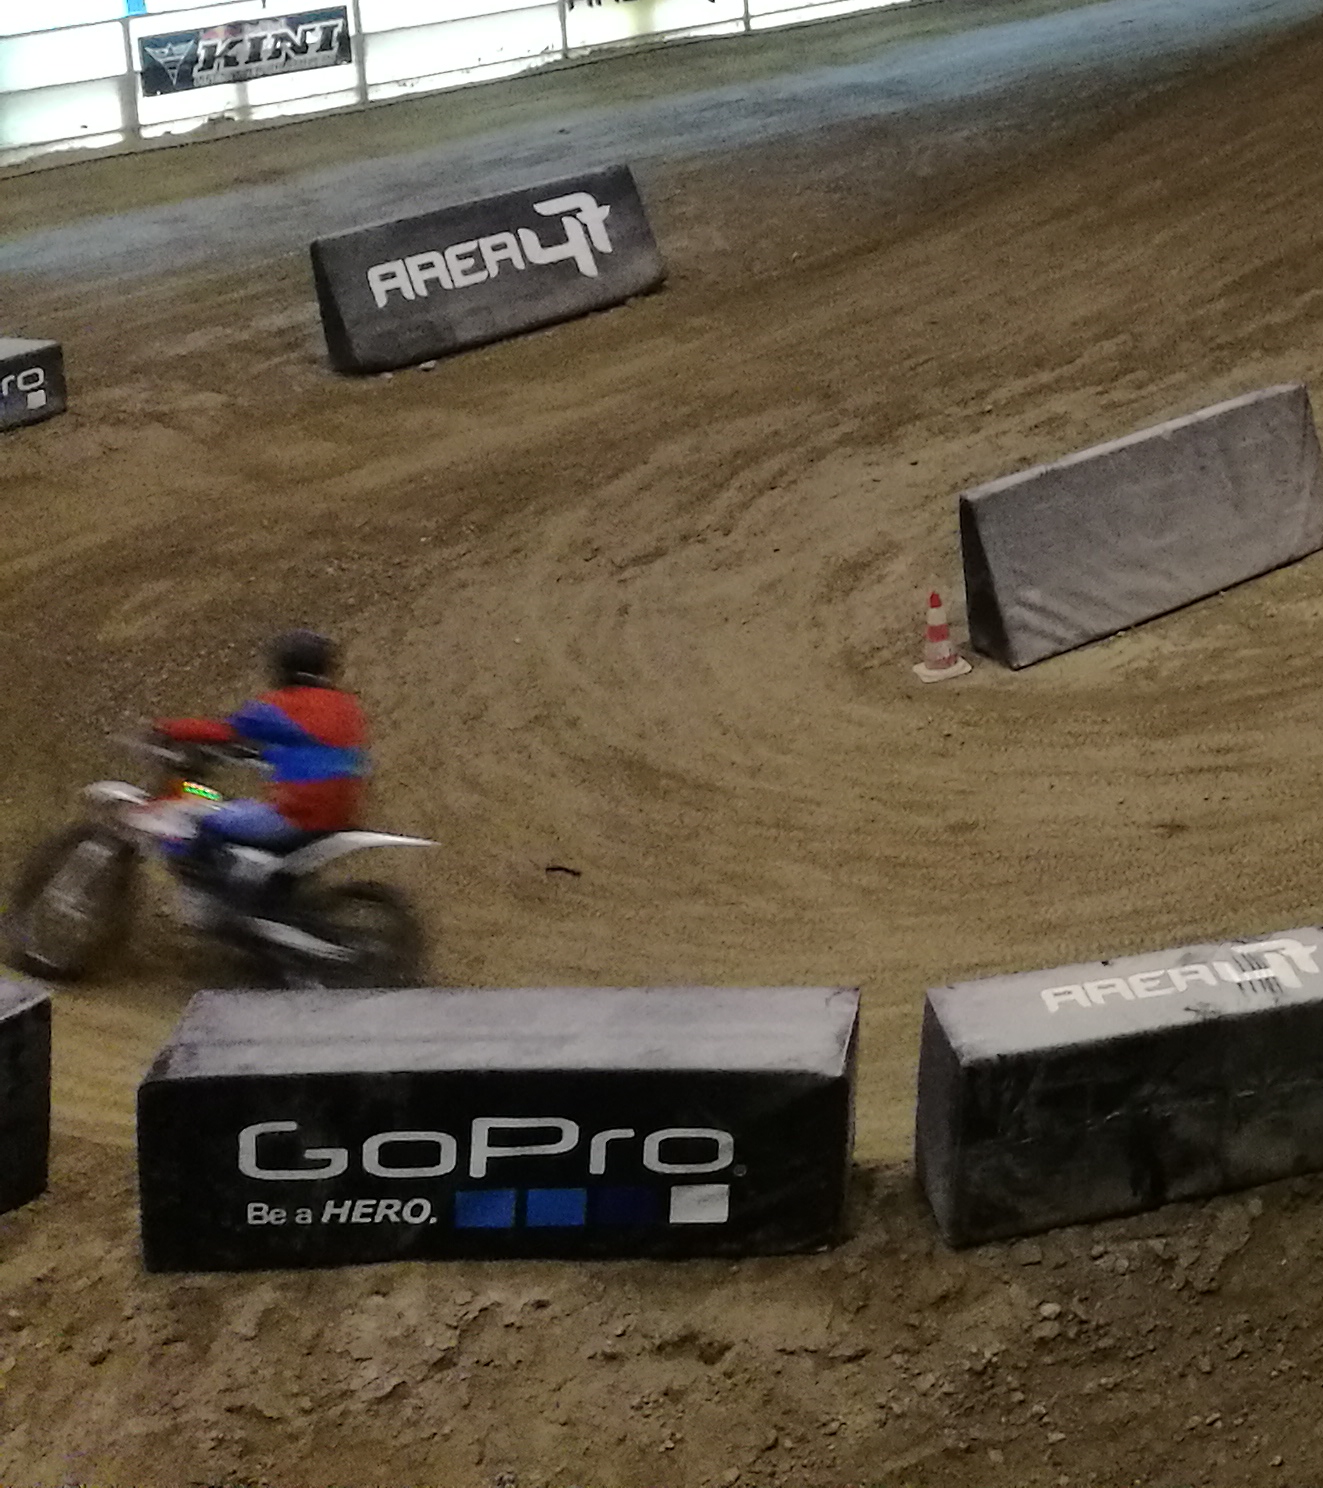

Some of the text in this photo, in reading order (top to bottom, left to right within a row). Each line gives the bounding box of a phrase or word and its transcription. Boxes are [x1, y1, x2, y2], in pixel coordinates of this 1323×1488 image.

[194, 20, 343, 74] KINI
[366, 192, 612, 308] AREA47
[1038, 938, 1318, 1014] AREA47
[237, 1116, 735, 1181] GoPro
[246, 1198, 438, 1226] Be a HERO.
